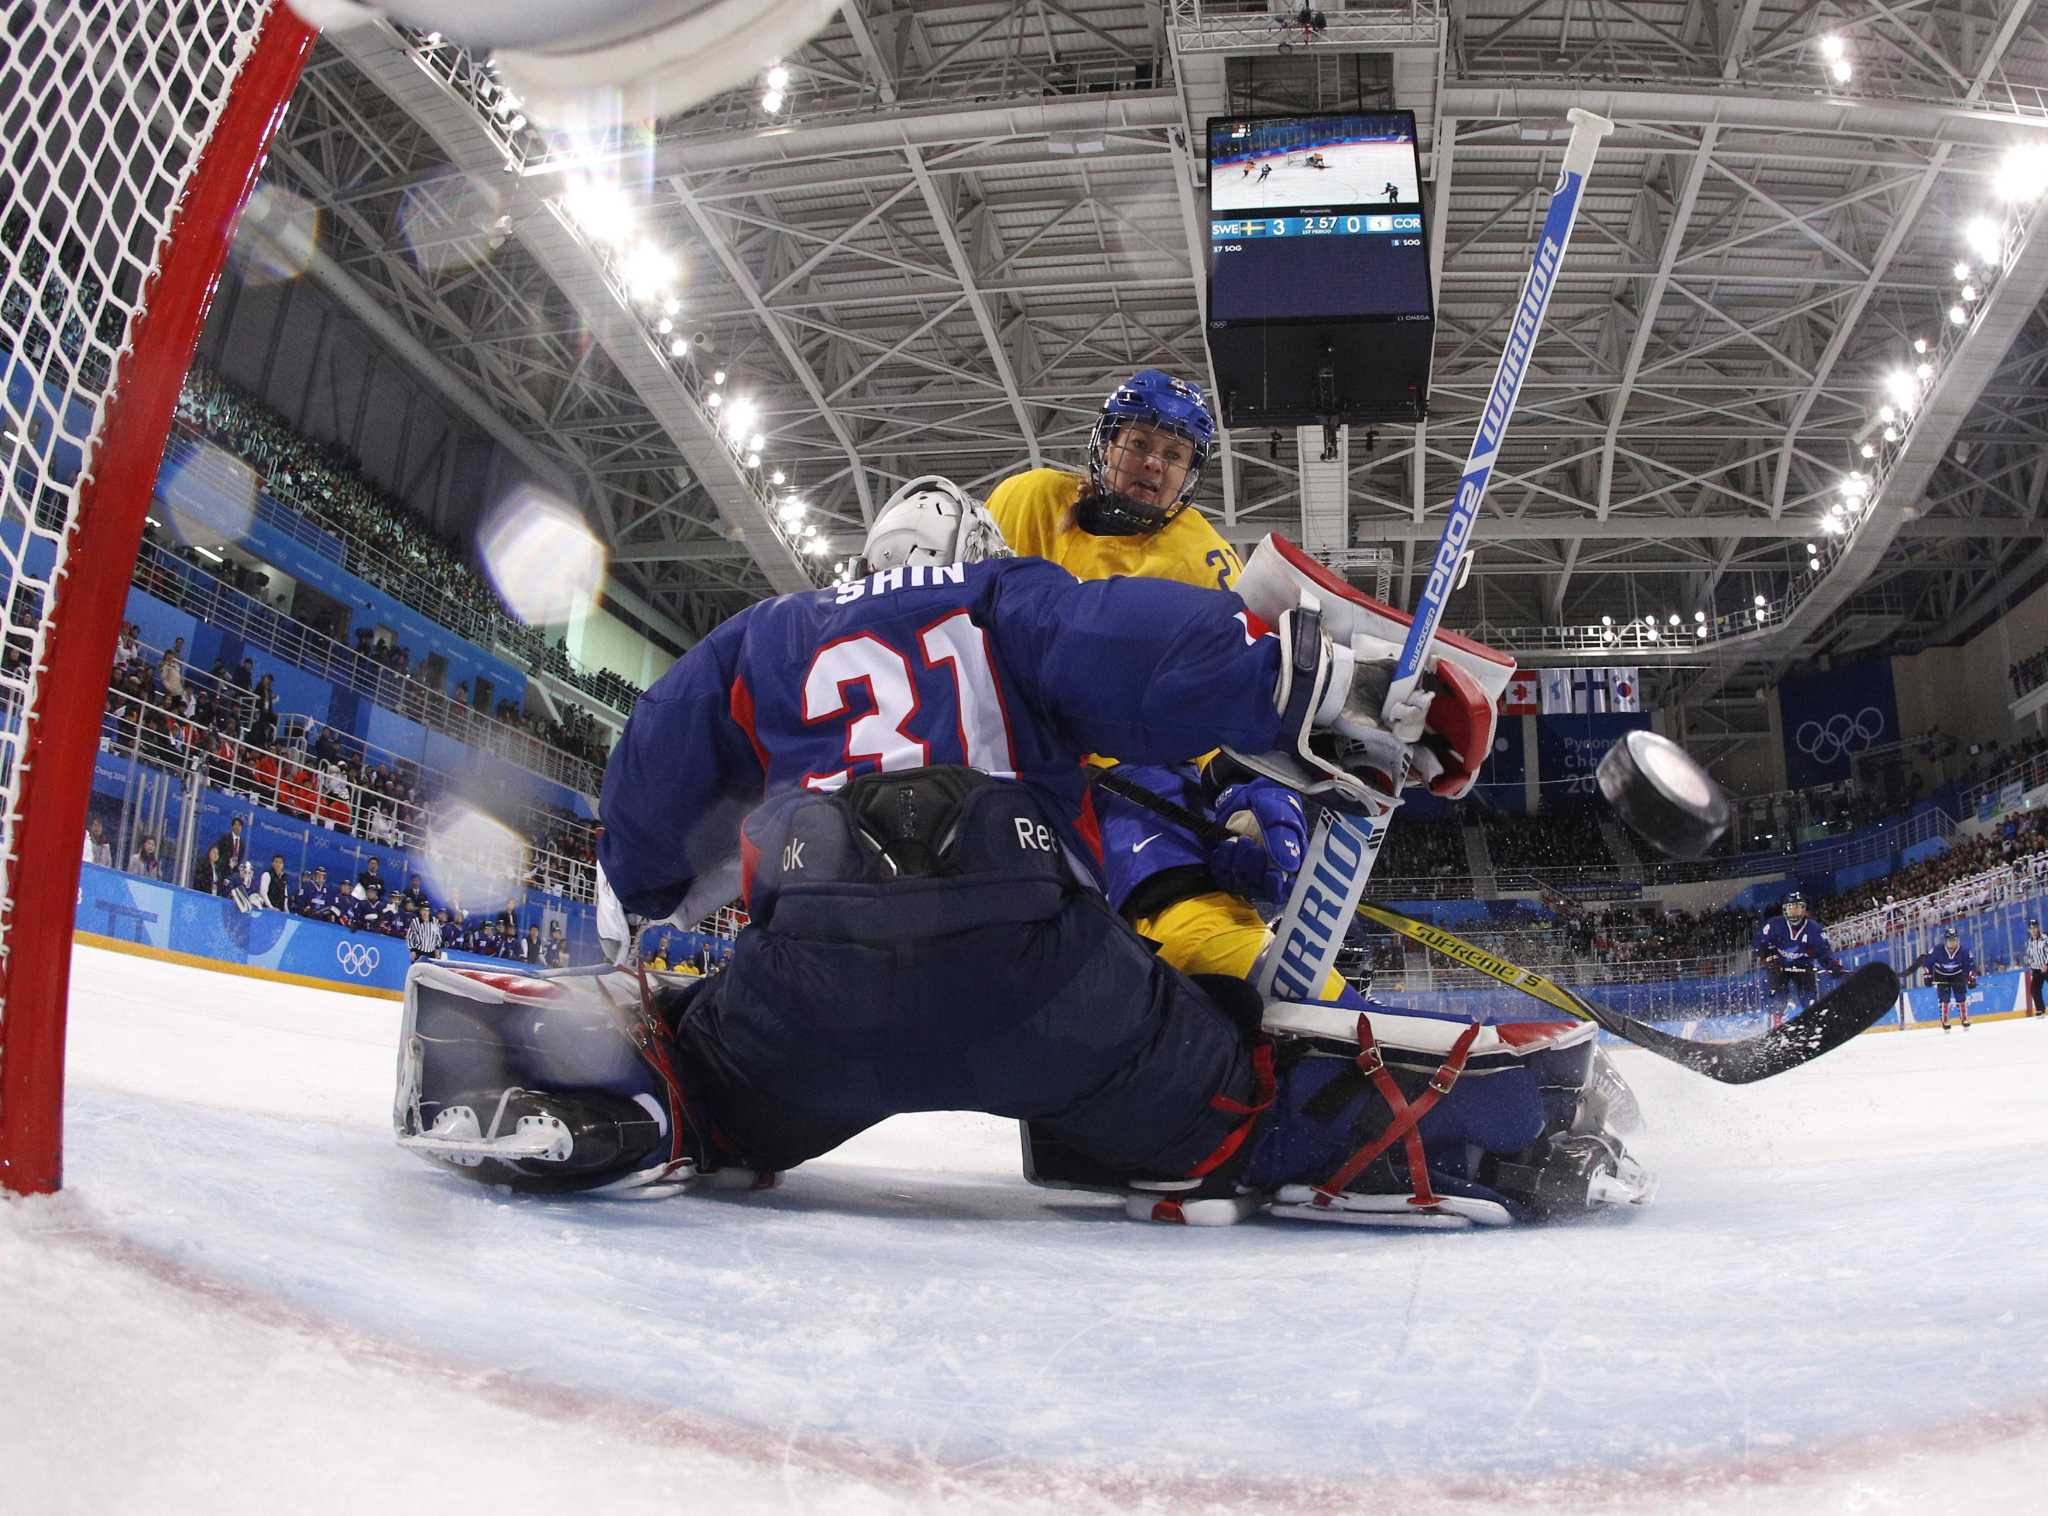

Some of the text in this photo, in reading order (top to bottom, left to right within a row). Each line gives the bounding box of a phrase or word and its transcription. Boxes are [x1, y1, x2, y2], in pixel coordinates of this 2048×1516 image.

[1212, 224, 1239, 235] SWE
[1273, 219, 1286, 235] 3
[1347, 216, 1360, 233] 0
[1393, 218, 1421, 228] COR
[1482, 236, 1560, 446] WARRIOR
[835, 561, 965, 604] SHIN
[1408, 607, 1436, 674] SWAGGER
[802, 608, 1023, 790] 31
[1564, 754, 1599, 768] Cha
[1568, 774, 1598, 793] 20
[1270, 815, 1374, 1000] ARRIO
